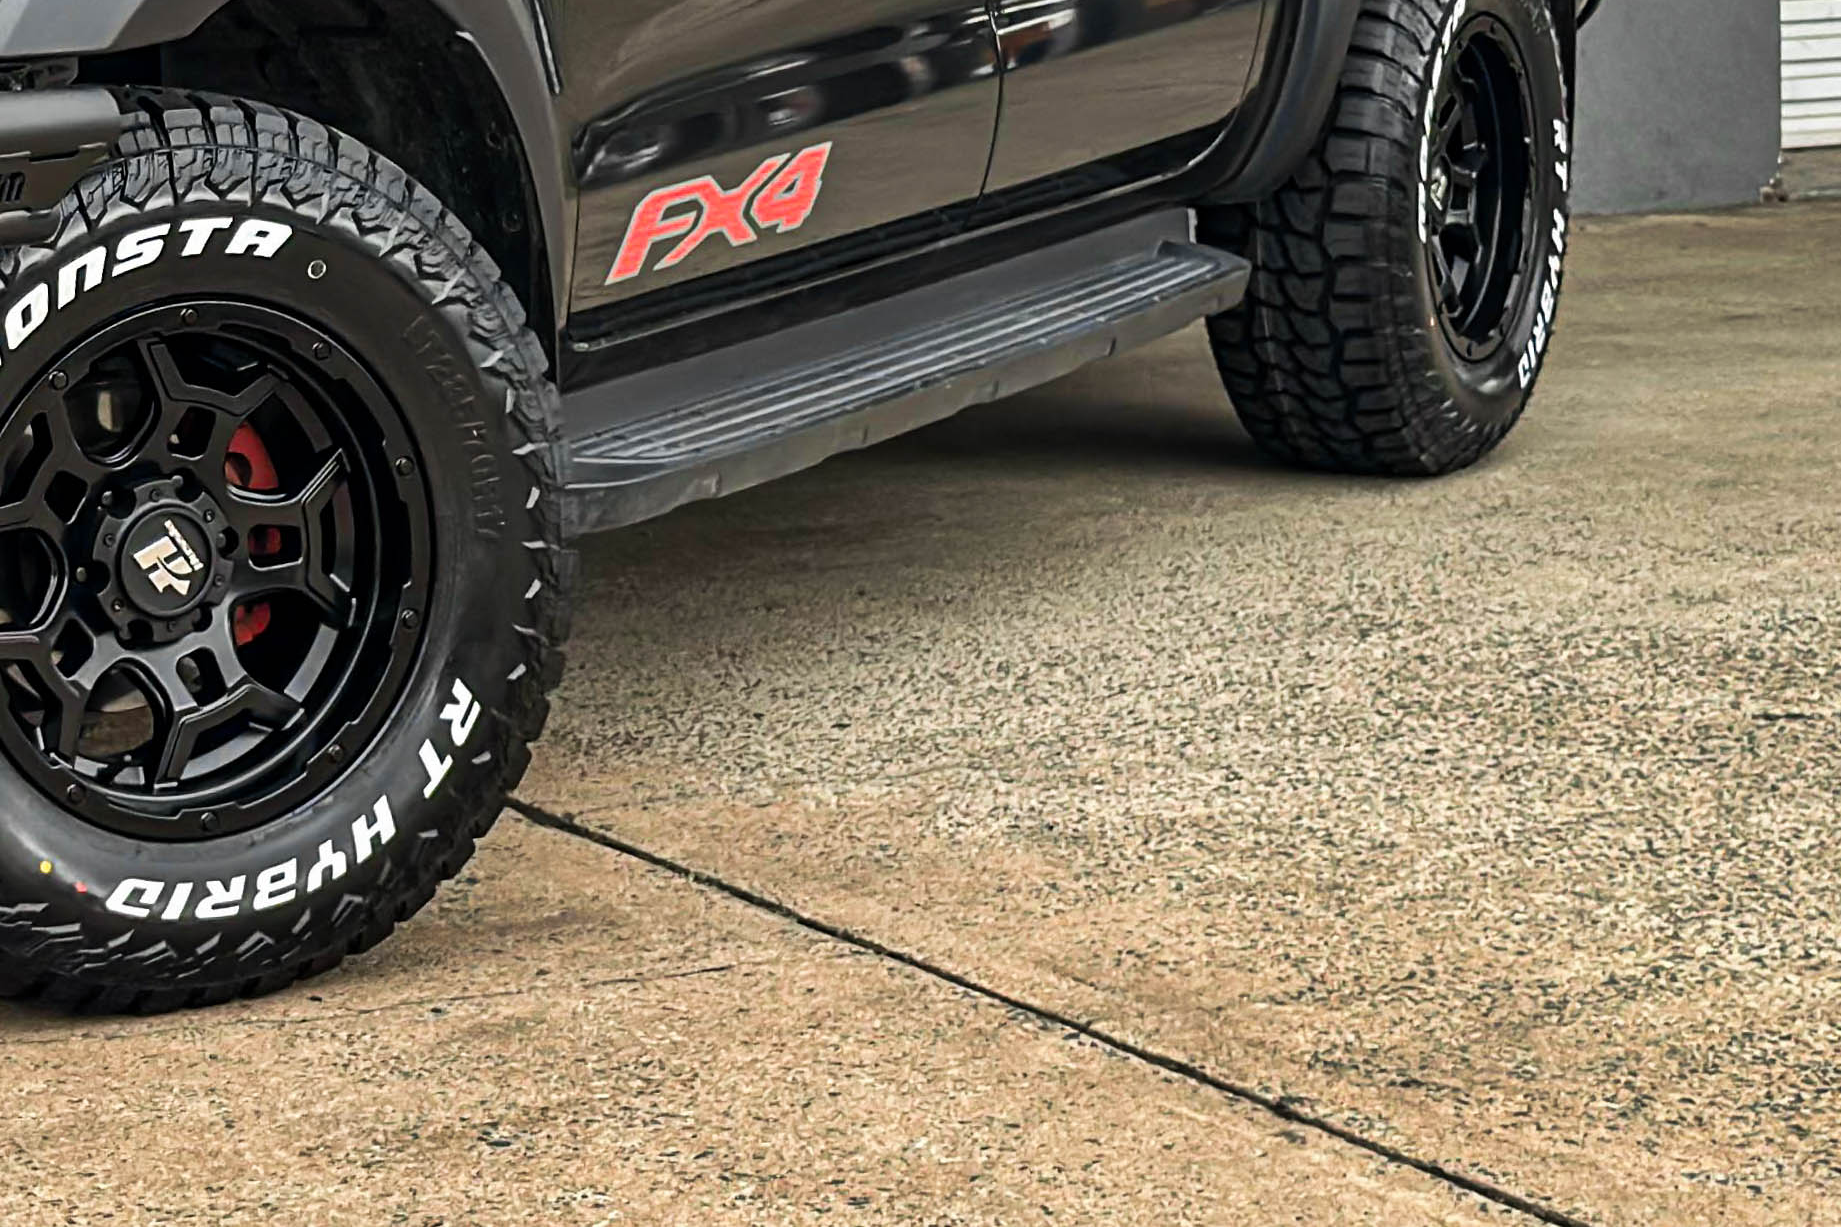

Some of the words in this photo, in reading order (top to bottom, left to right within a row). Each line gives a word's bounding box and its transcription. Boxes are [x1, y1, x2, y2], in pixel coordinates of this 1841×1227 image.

[605, 141, 832, 285] FX4
[418, 677, 482, 800] RT
[105, 794, 397, 920] HYBRID
